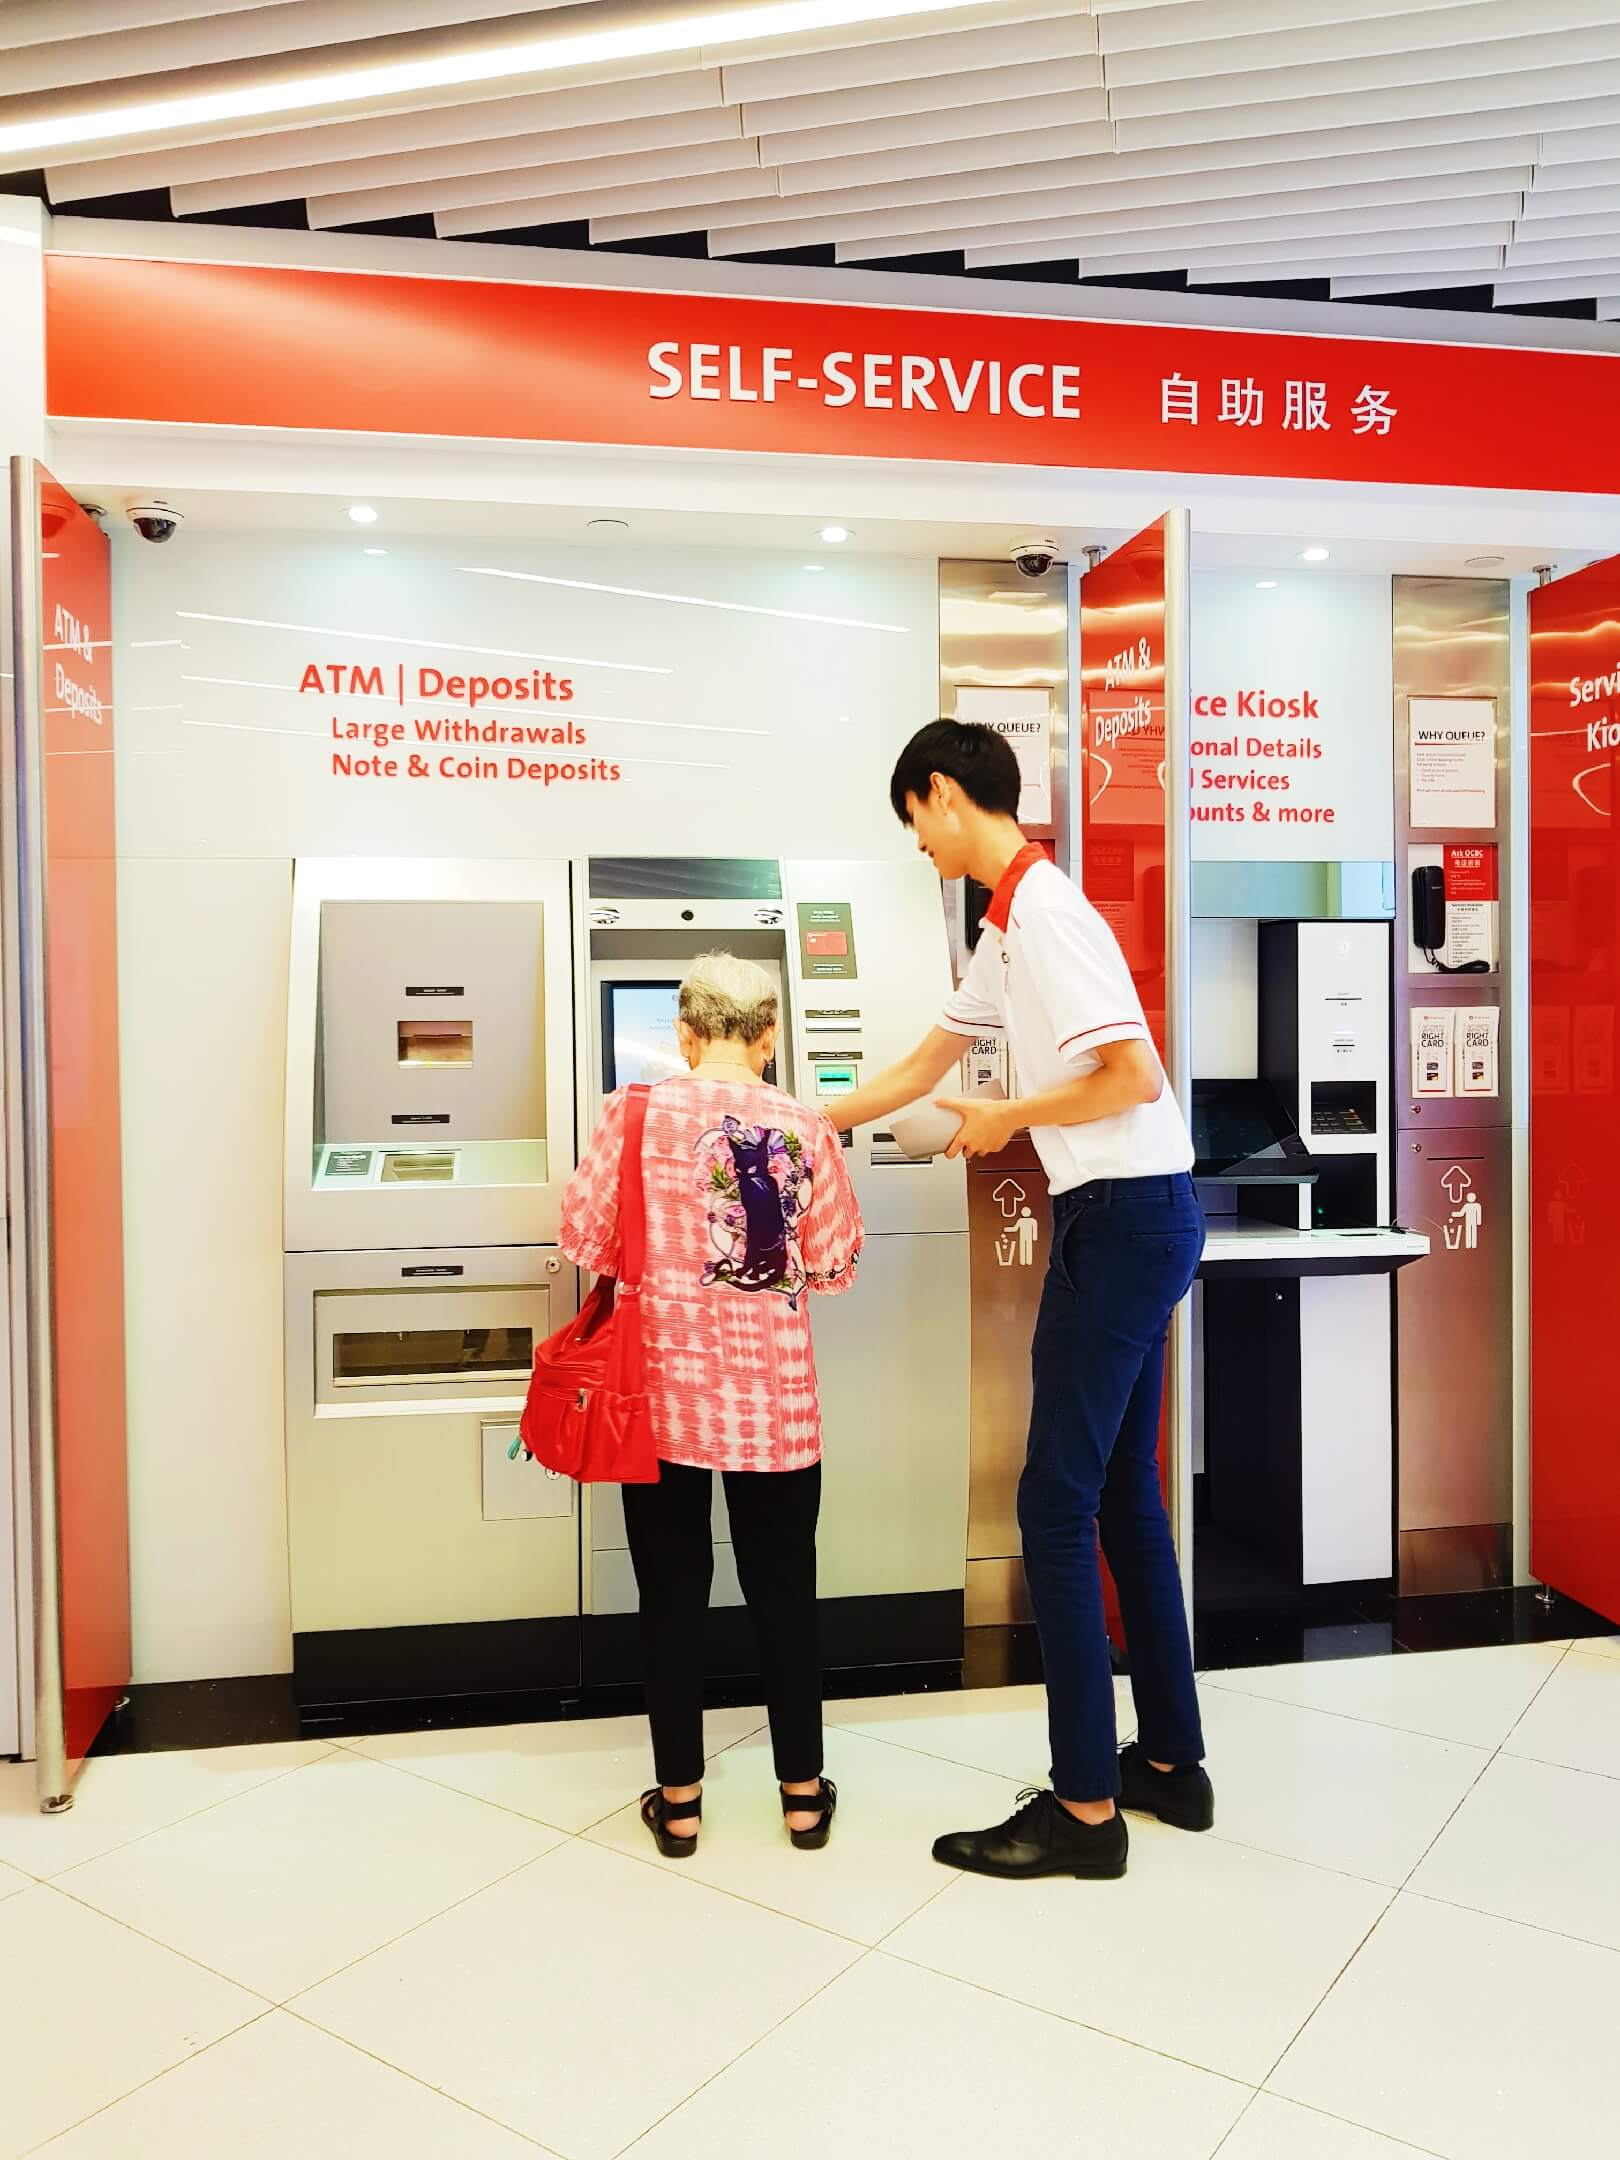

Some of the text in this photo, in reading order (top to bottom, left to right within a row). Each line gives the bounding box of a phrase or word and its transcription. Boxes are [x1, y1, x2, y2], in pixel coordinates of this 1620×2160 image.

[647, 341, 1082, 421] SELF-SERVICE
[1159, 371, 1399, 436] 自助服务
[54, 603, 93, 664] ATM &
[1105, 636, 1151, 692] ATM &
[55, 662, 103, 726] Deposits
[299, 664, 384, 696] ATM
[418, 668, 575, 708] Deposits
[1237, 690, 1320, 718] Kiosk
[332, 717, 587, 747] Large Withdrawals
[997, 722, 1041, 733] QUEUE?
[1095, 695, 1151, 749] Deposits
[1418, 730, 1444, 740] WHY
[1246, 738, 1323, 759] Details
[332, 753, 621, 786] Note & Coin Deposits
[1201, 769, 1290, 790] Services
[1251, 801, 1270, 823] &
[1278, 806, 1335, 823] more
[971, 1046, 997, 1055] CARD
[1421, 1040, 1444, 1048] CARD
[1466, 1039, 1489, 1047] CARD
